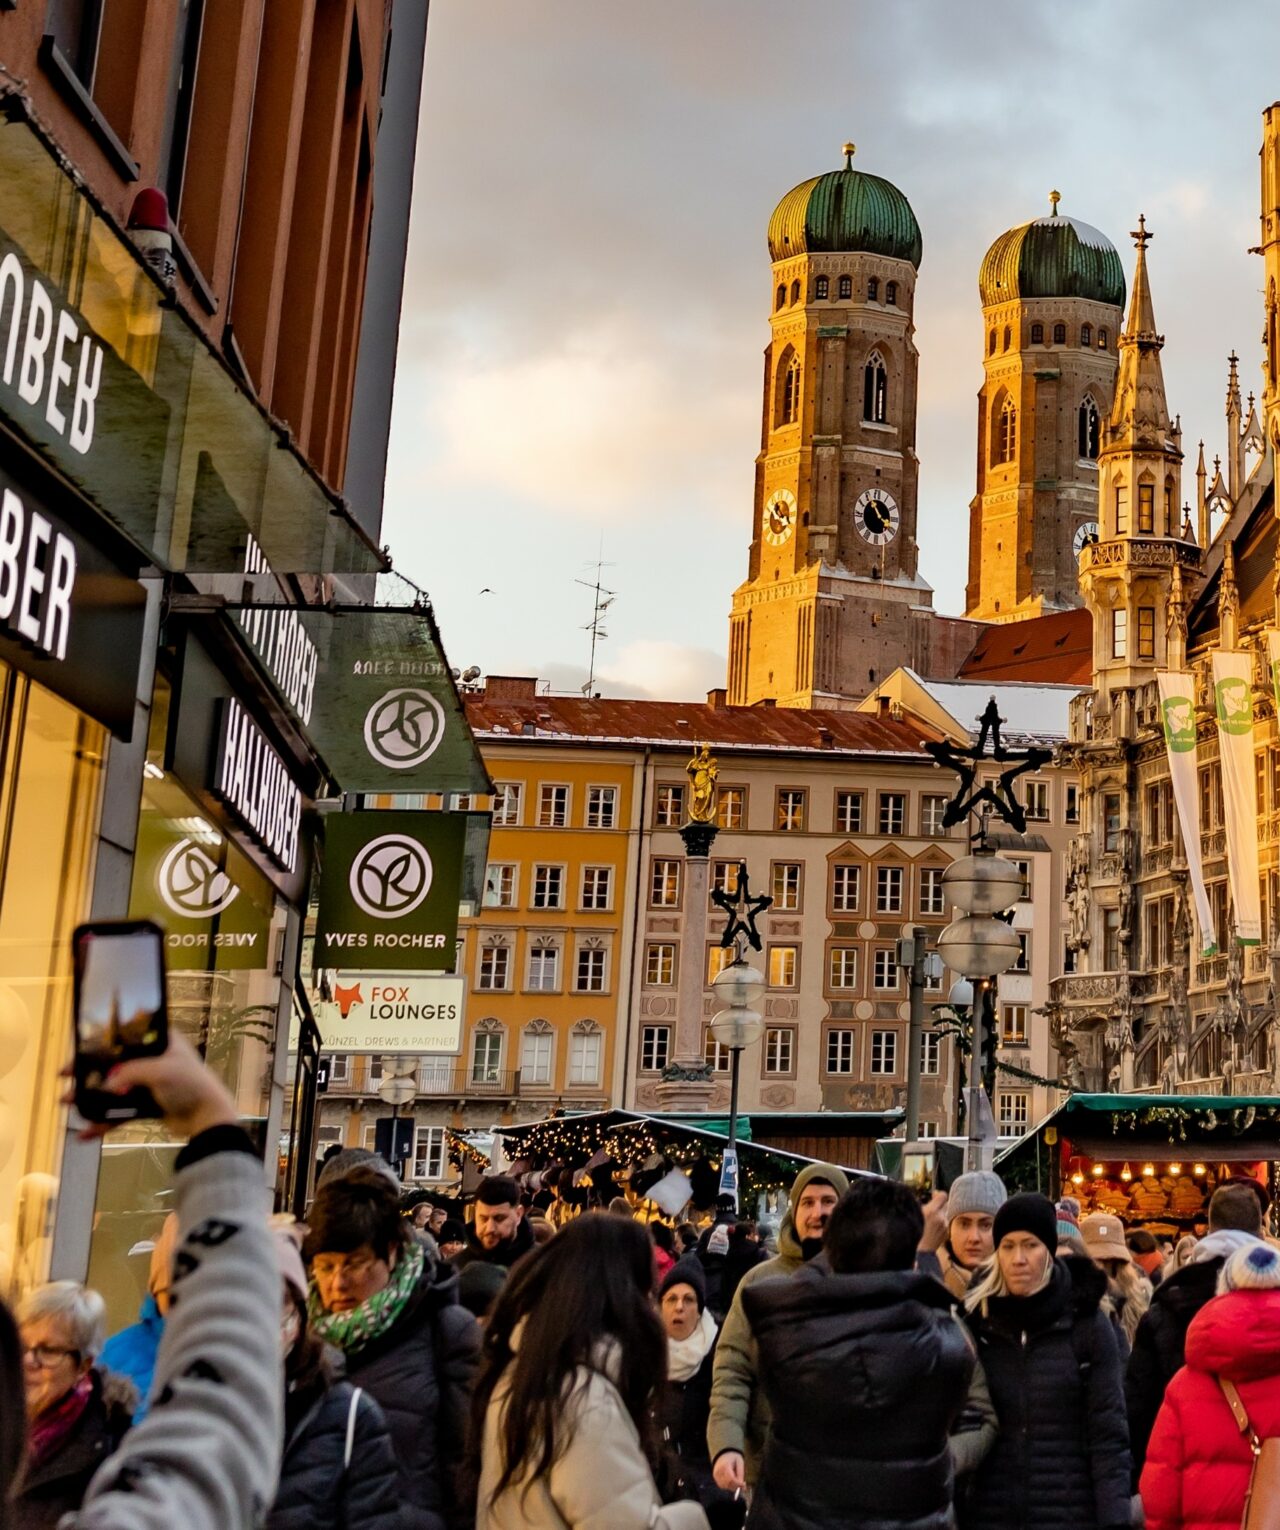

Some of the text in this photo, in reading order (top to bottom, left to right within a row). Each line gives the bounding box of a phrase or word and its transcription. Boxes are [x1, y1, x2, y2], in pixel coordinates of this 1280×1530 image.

[221, 697, 301, 874] HALLHUBER
[325, 933, 446, 948] YVES ROCHER
[371, 987, 410, 1002] FOX
[370, 1004, 457, 1020] LOUNGES
[364, 1036, 400, 1046] DREWS
[411, 1036, 456, 1046] PARTNER
